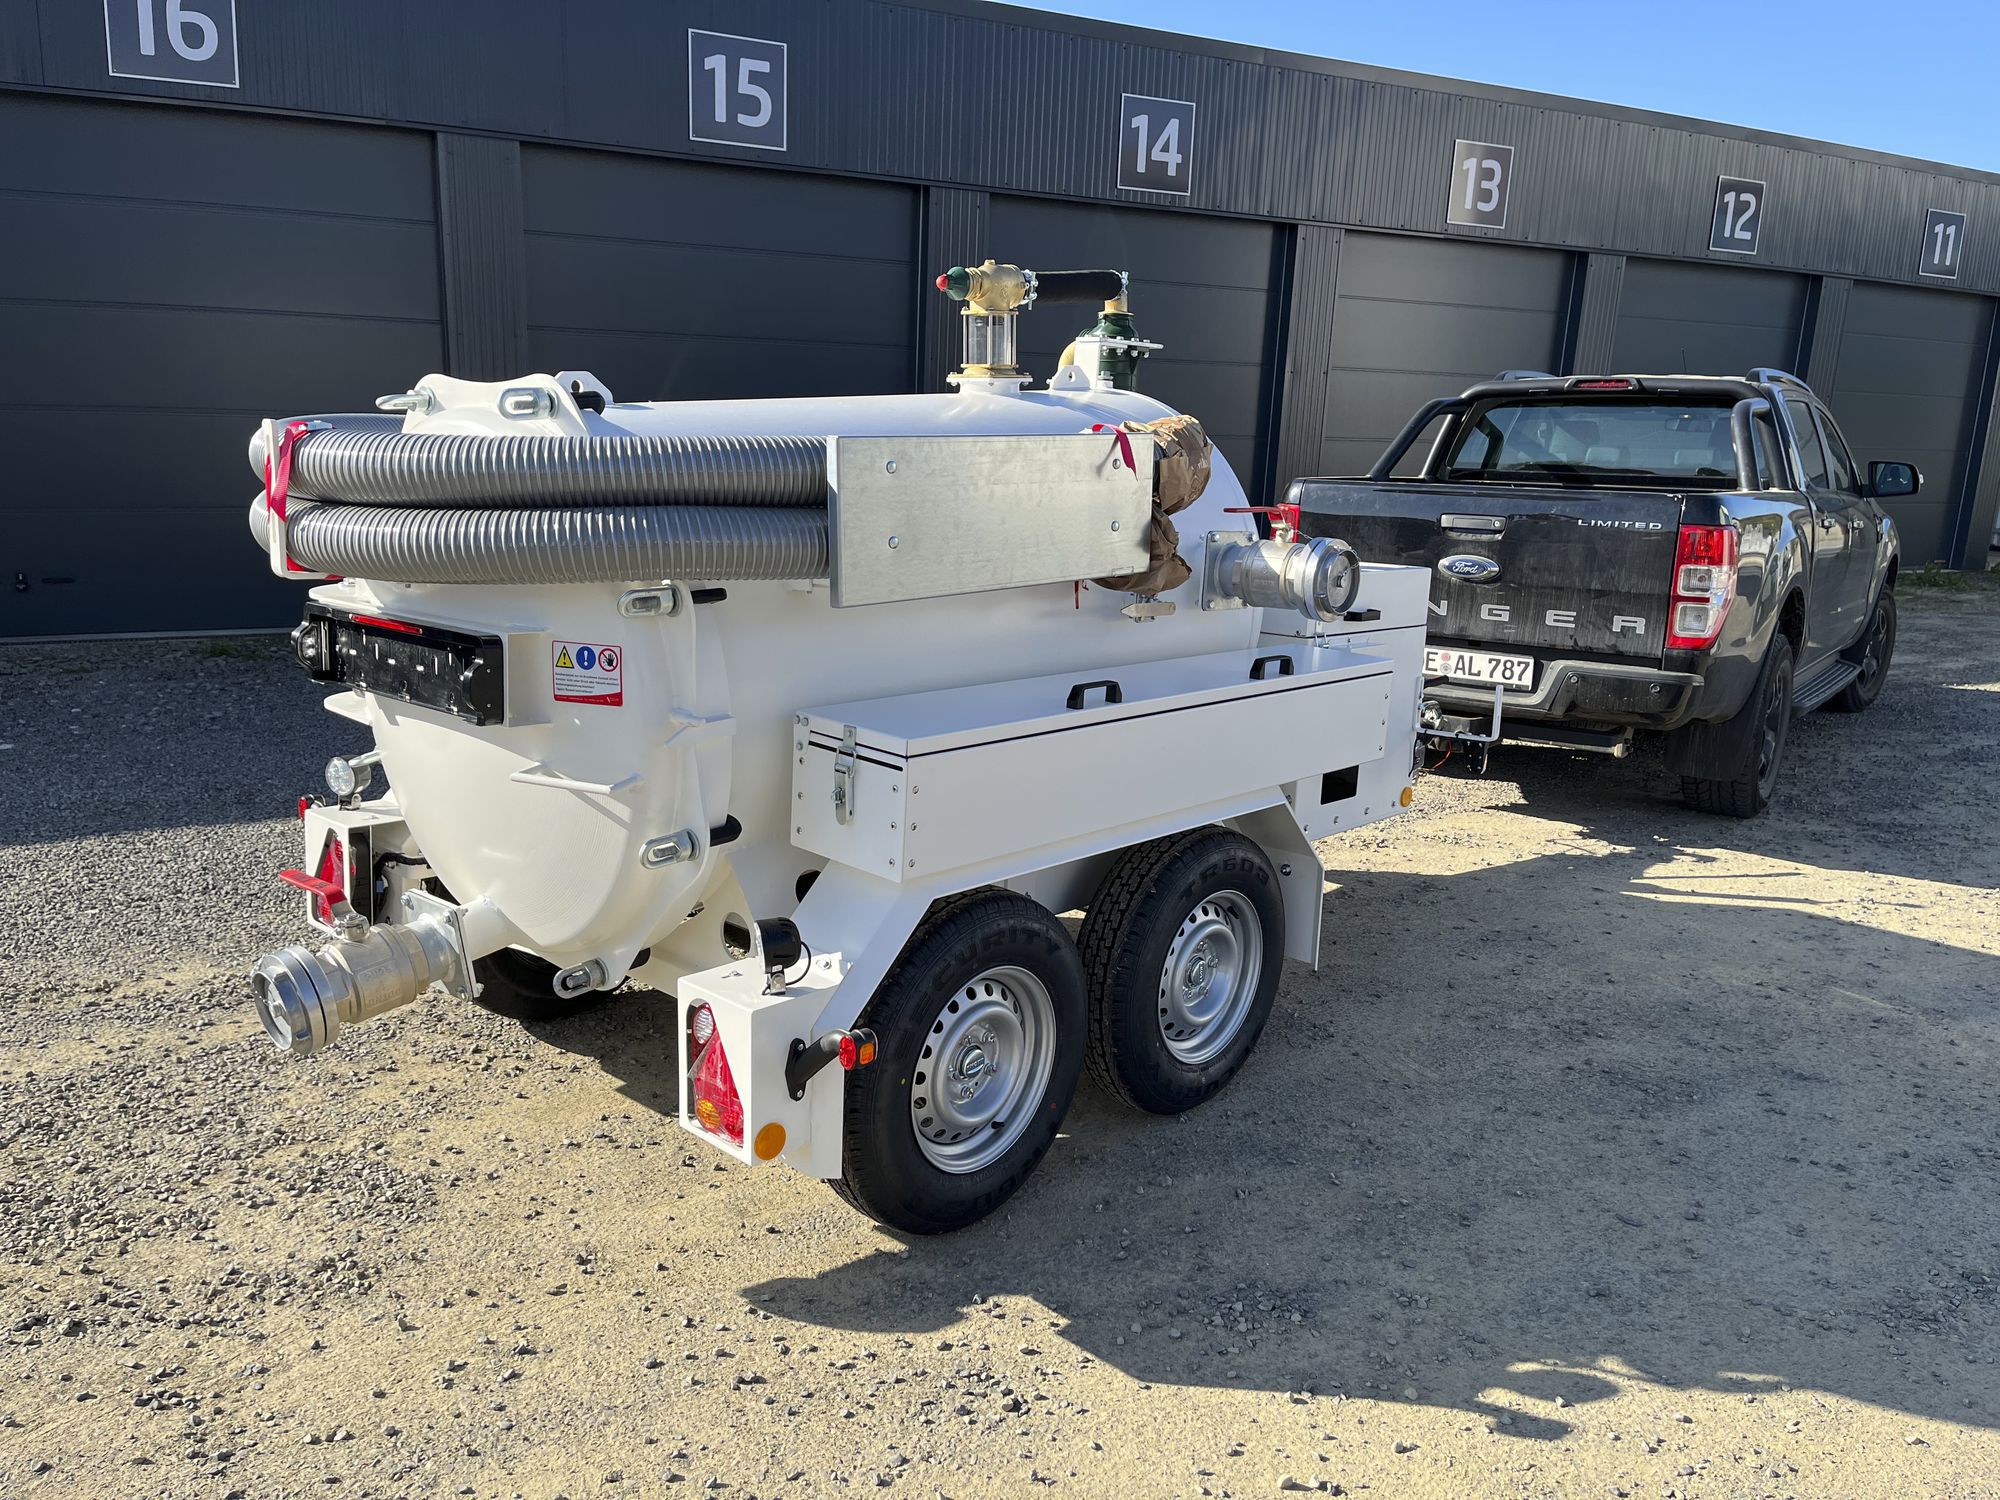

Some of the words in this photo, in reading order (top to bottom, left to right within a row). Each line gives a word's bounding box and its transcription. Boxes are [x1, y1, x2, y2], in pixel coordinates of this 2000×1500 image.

[136, 0, 219, 62] 16
[703, 54, 771, 128] 15
[1131, 114, 1182, 176] 14
[1462, 157, 1502, 212] 13
[1723, 191, 1756, 240] 12
[1933, 223, 1956, 266] 11
[1577, 519, 1662, 530] LIMITED
[1452, 560, 1479, 574] Ford
[1427, 599, 1646, 634] NGER
[1453, 654, 1482, 677] AL
[1488, 657, 1531, 682] 787
